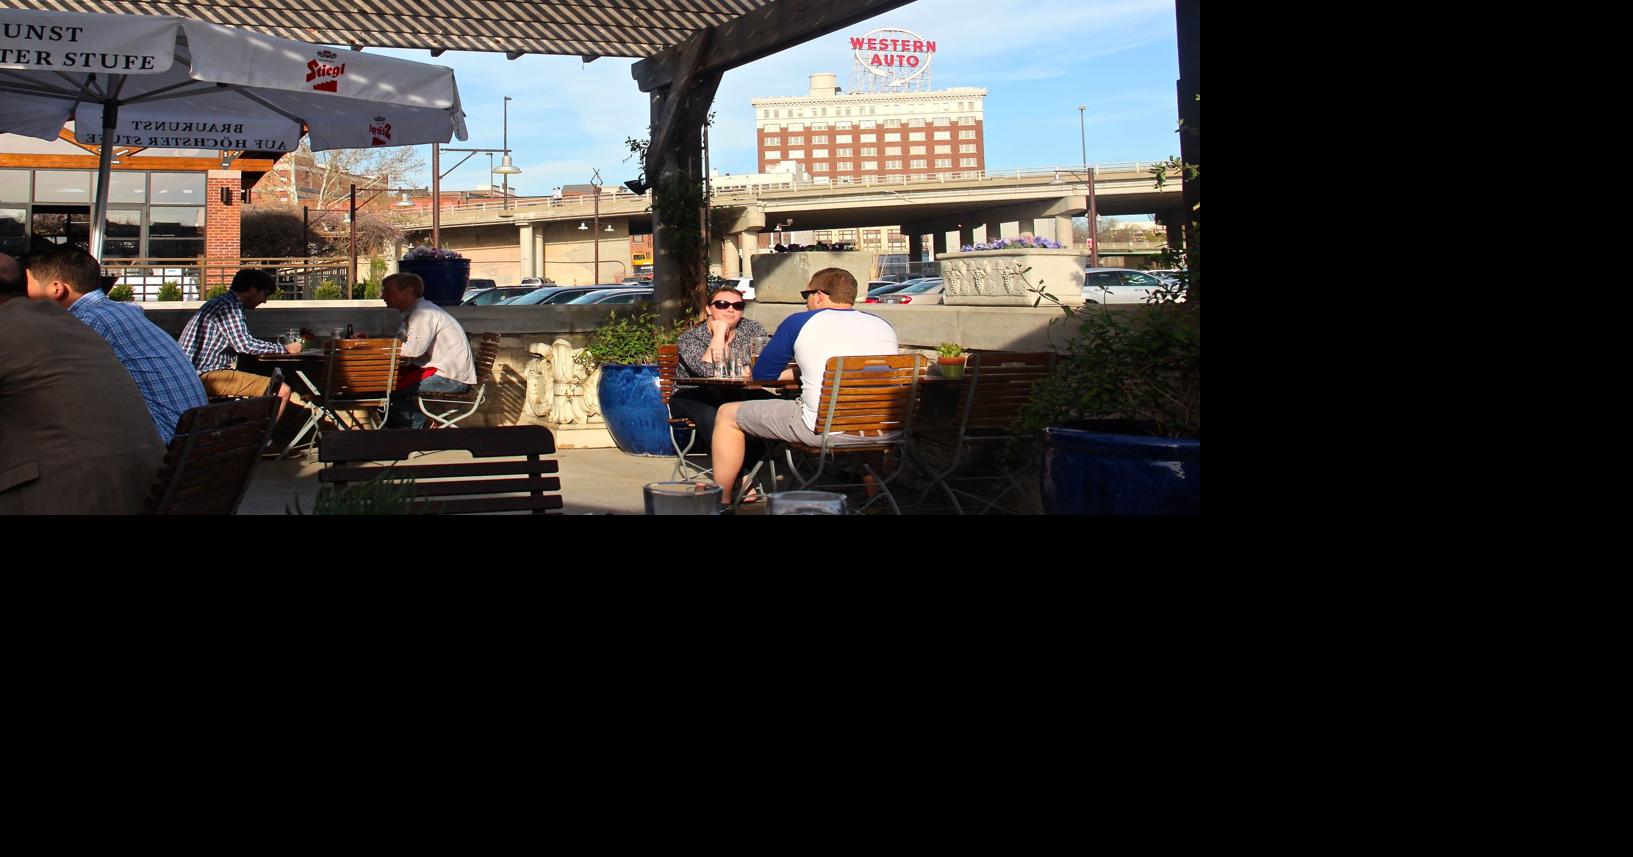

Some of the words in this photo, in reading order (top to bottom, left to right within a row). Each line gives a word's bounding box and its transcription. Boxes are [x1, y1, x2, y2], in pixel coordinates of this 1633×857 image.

[850, 37, 936, 53] WESTERN
[63, 52, 155, 70] STUFE
[870, 54, 920, 68] AUTO
[306, 58, 345, 82] Stiegl
